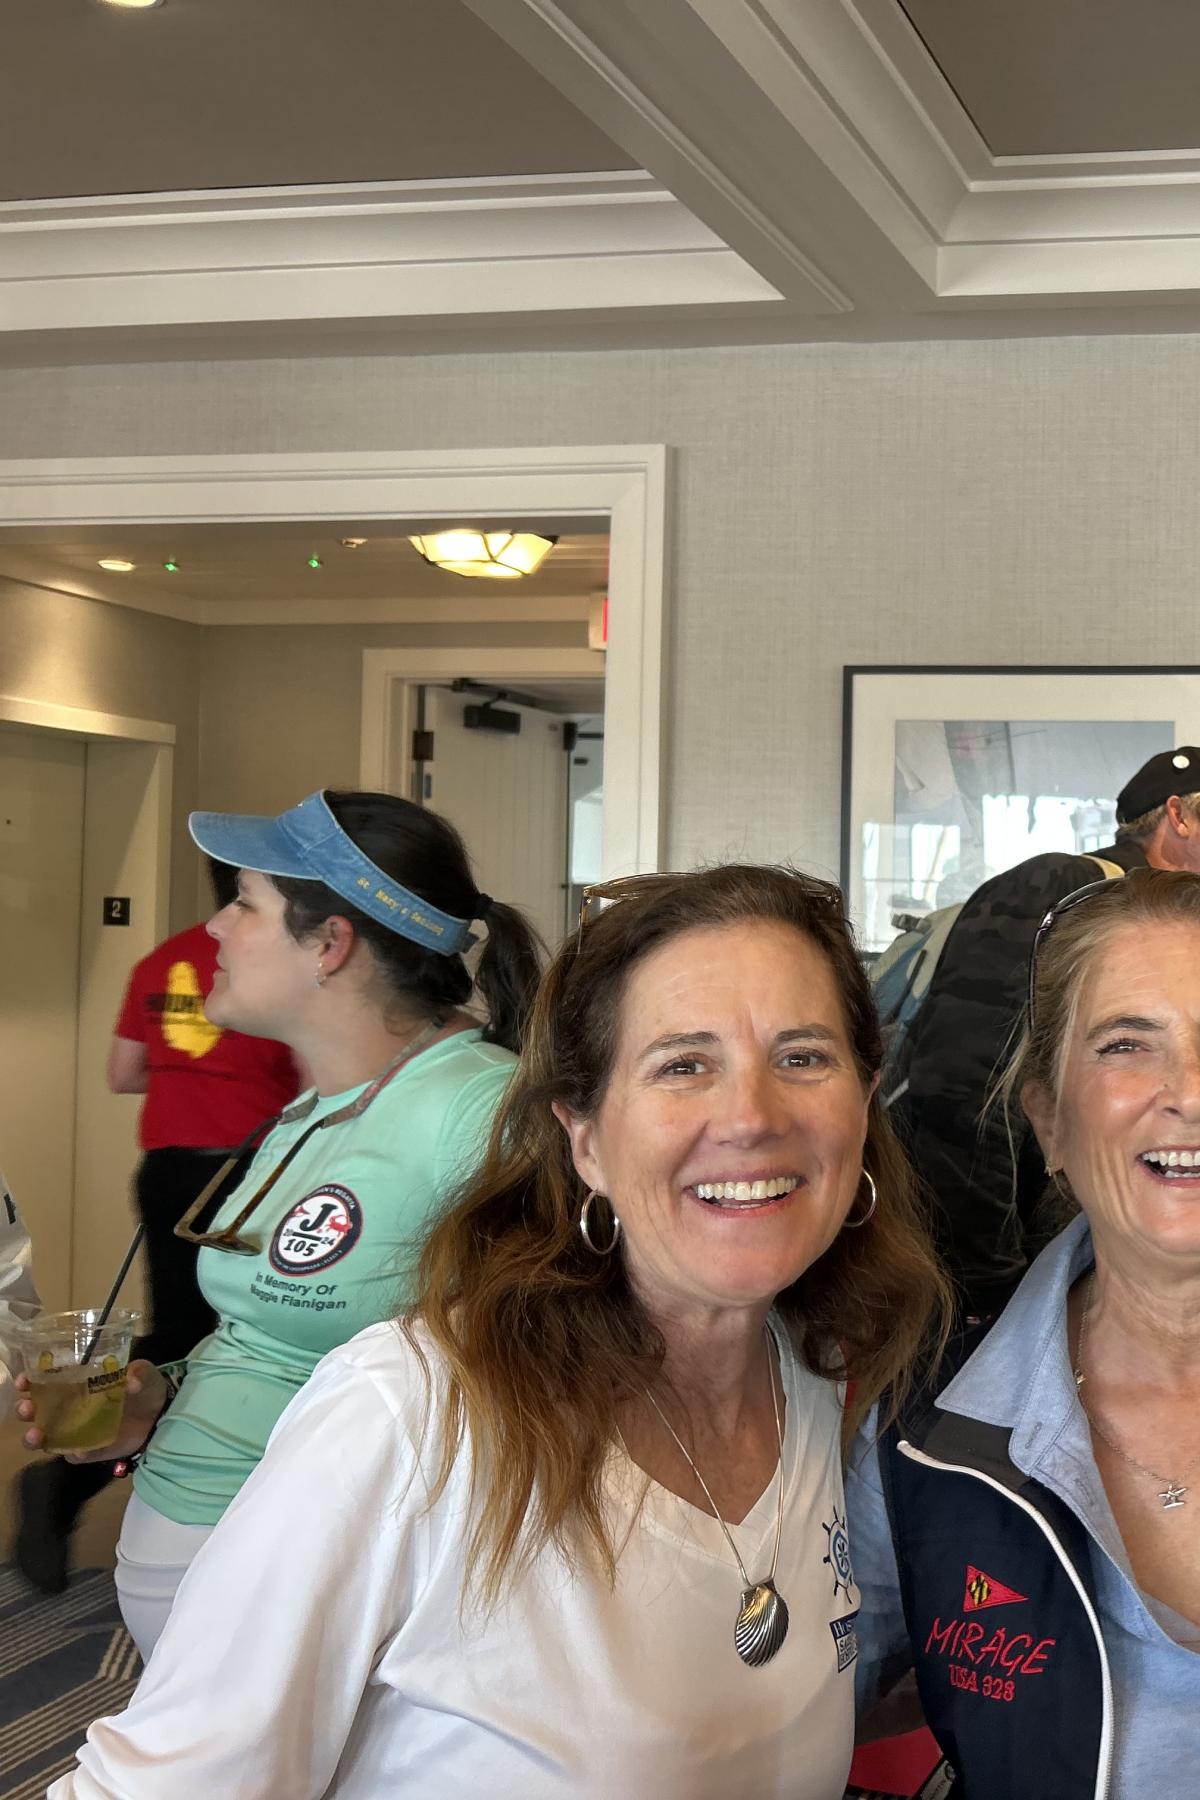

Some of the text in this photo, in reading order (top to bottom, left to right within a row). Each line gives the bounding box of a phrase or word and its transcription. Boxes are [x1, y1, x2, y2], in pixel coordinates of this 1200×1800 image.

[111, 900, 121, 918] 2
[283, 1238, 319, 1257] 105
[263, 1274, 312, 1296] Memory
[316, 1284, 338, 1295] Of
[280, 1294, 347, 1312] Flanigan
[948, 1663, 1017, 1702] USA 328
